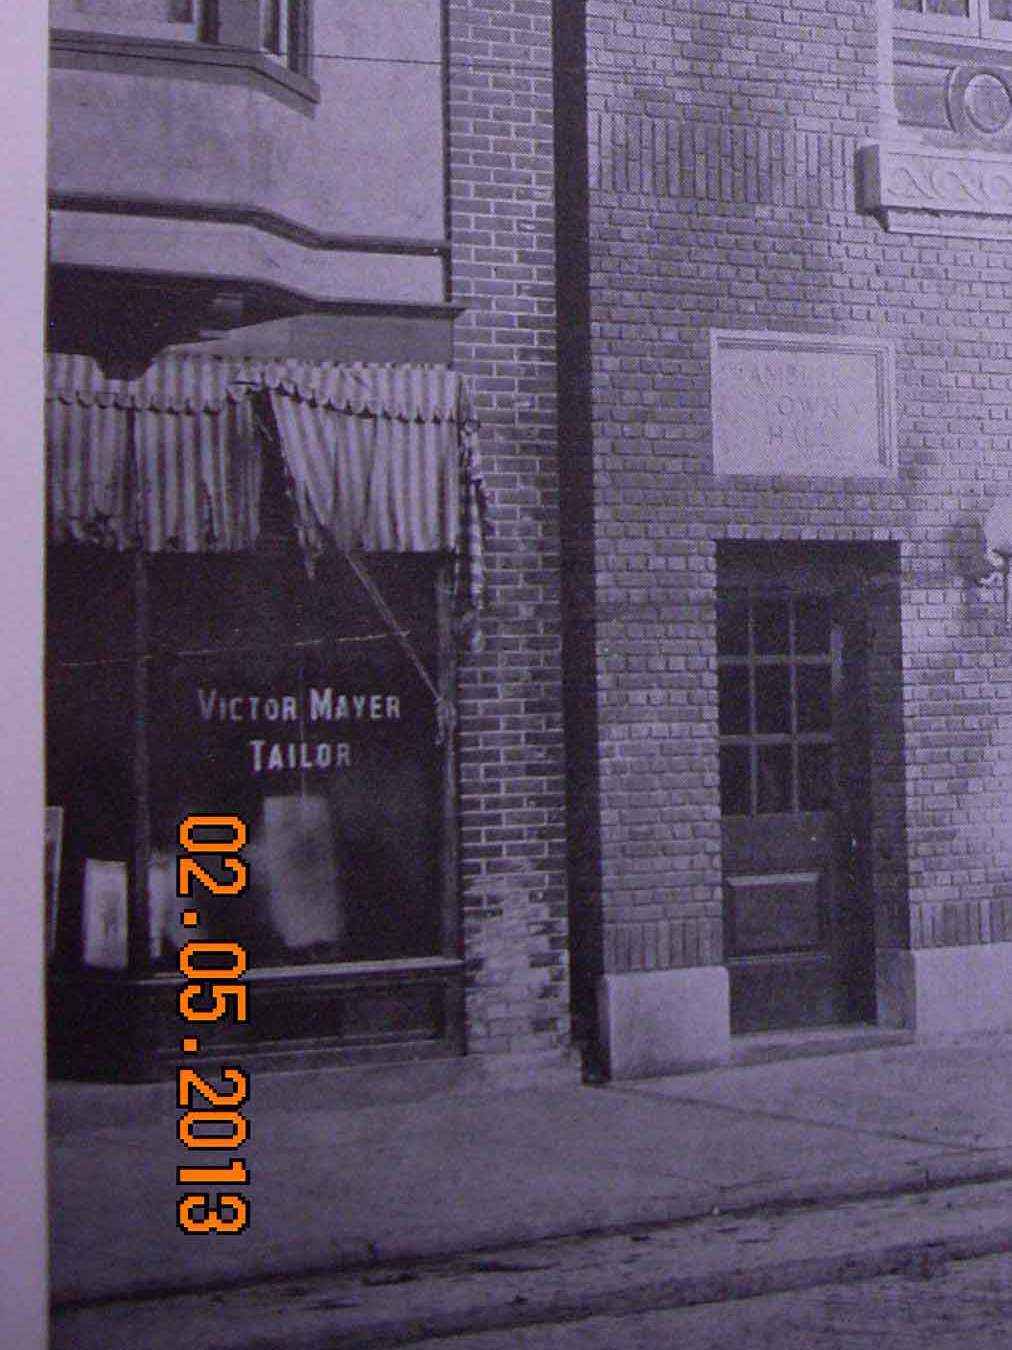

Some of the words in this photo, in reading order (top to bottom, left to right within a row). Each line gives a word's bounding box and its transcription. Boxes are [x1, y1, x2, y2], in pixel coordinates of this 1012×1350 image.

[198, 689, 297, 721] VICTOR
[309, 687, 401, 721] MAYER
[249, 739, 352, 772] TAILOR
